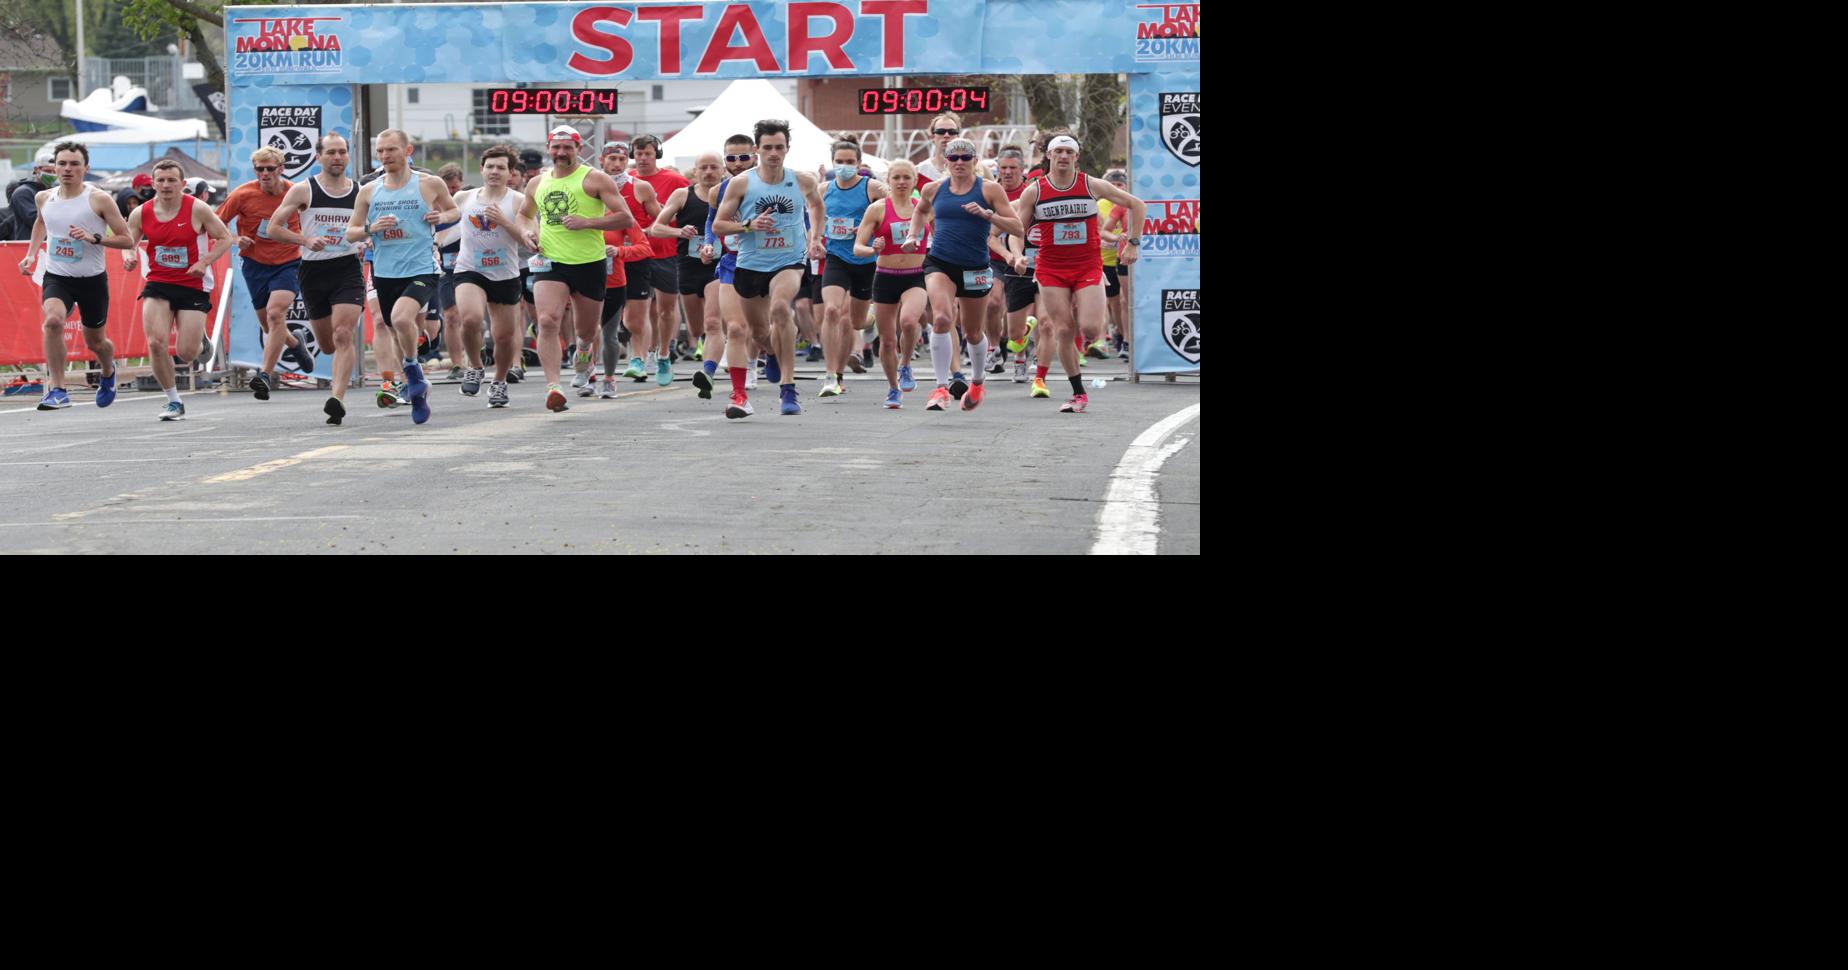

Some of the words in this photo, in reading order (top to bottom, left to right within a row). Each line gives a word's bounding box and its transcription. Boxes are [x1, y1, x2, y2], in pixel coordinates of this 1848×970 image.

[259, 19, 314, 37] LAKE
[1137, 21, 1200, 39] MON
[568, 0, 928, 76] START
[1136, 38, 1200, 55] 20KM
[235, 52, 293, 68] 20KM
[299, 51, 341, 67] RUN
[492, 90, 614, 112] 09:00:04
[862, 89, 986, 112] 09:00:04
[1163, 94, 1195, 103] RACE
[262, 108, 292, 117] RACE
[294, 107, 319, 117] DAY
[260, 116, 316, 127] EVENTS
[1043, 205, 1060, 217] EDEN
[1060, 203, 1088, 215] PRAIRIE
[831, 225, 847, 235] 735
[1142, 218, 1200, 236] MON
[1062, 230, 1080, 240] 793
[764, 237, 785, 249] 773
[1142, 235, 1199, 251] 20KM
[55, 246, 74, 257] 245
[1166, 291, 1196, 300] RACE
